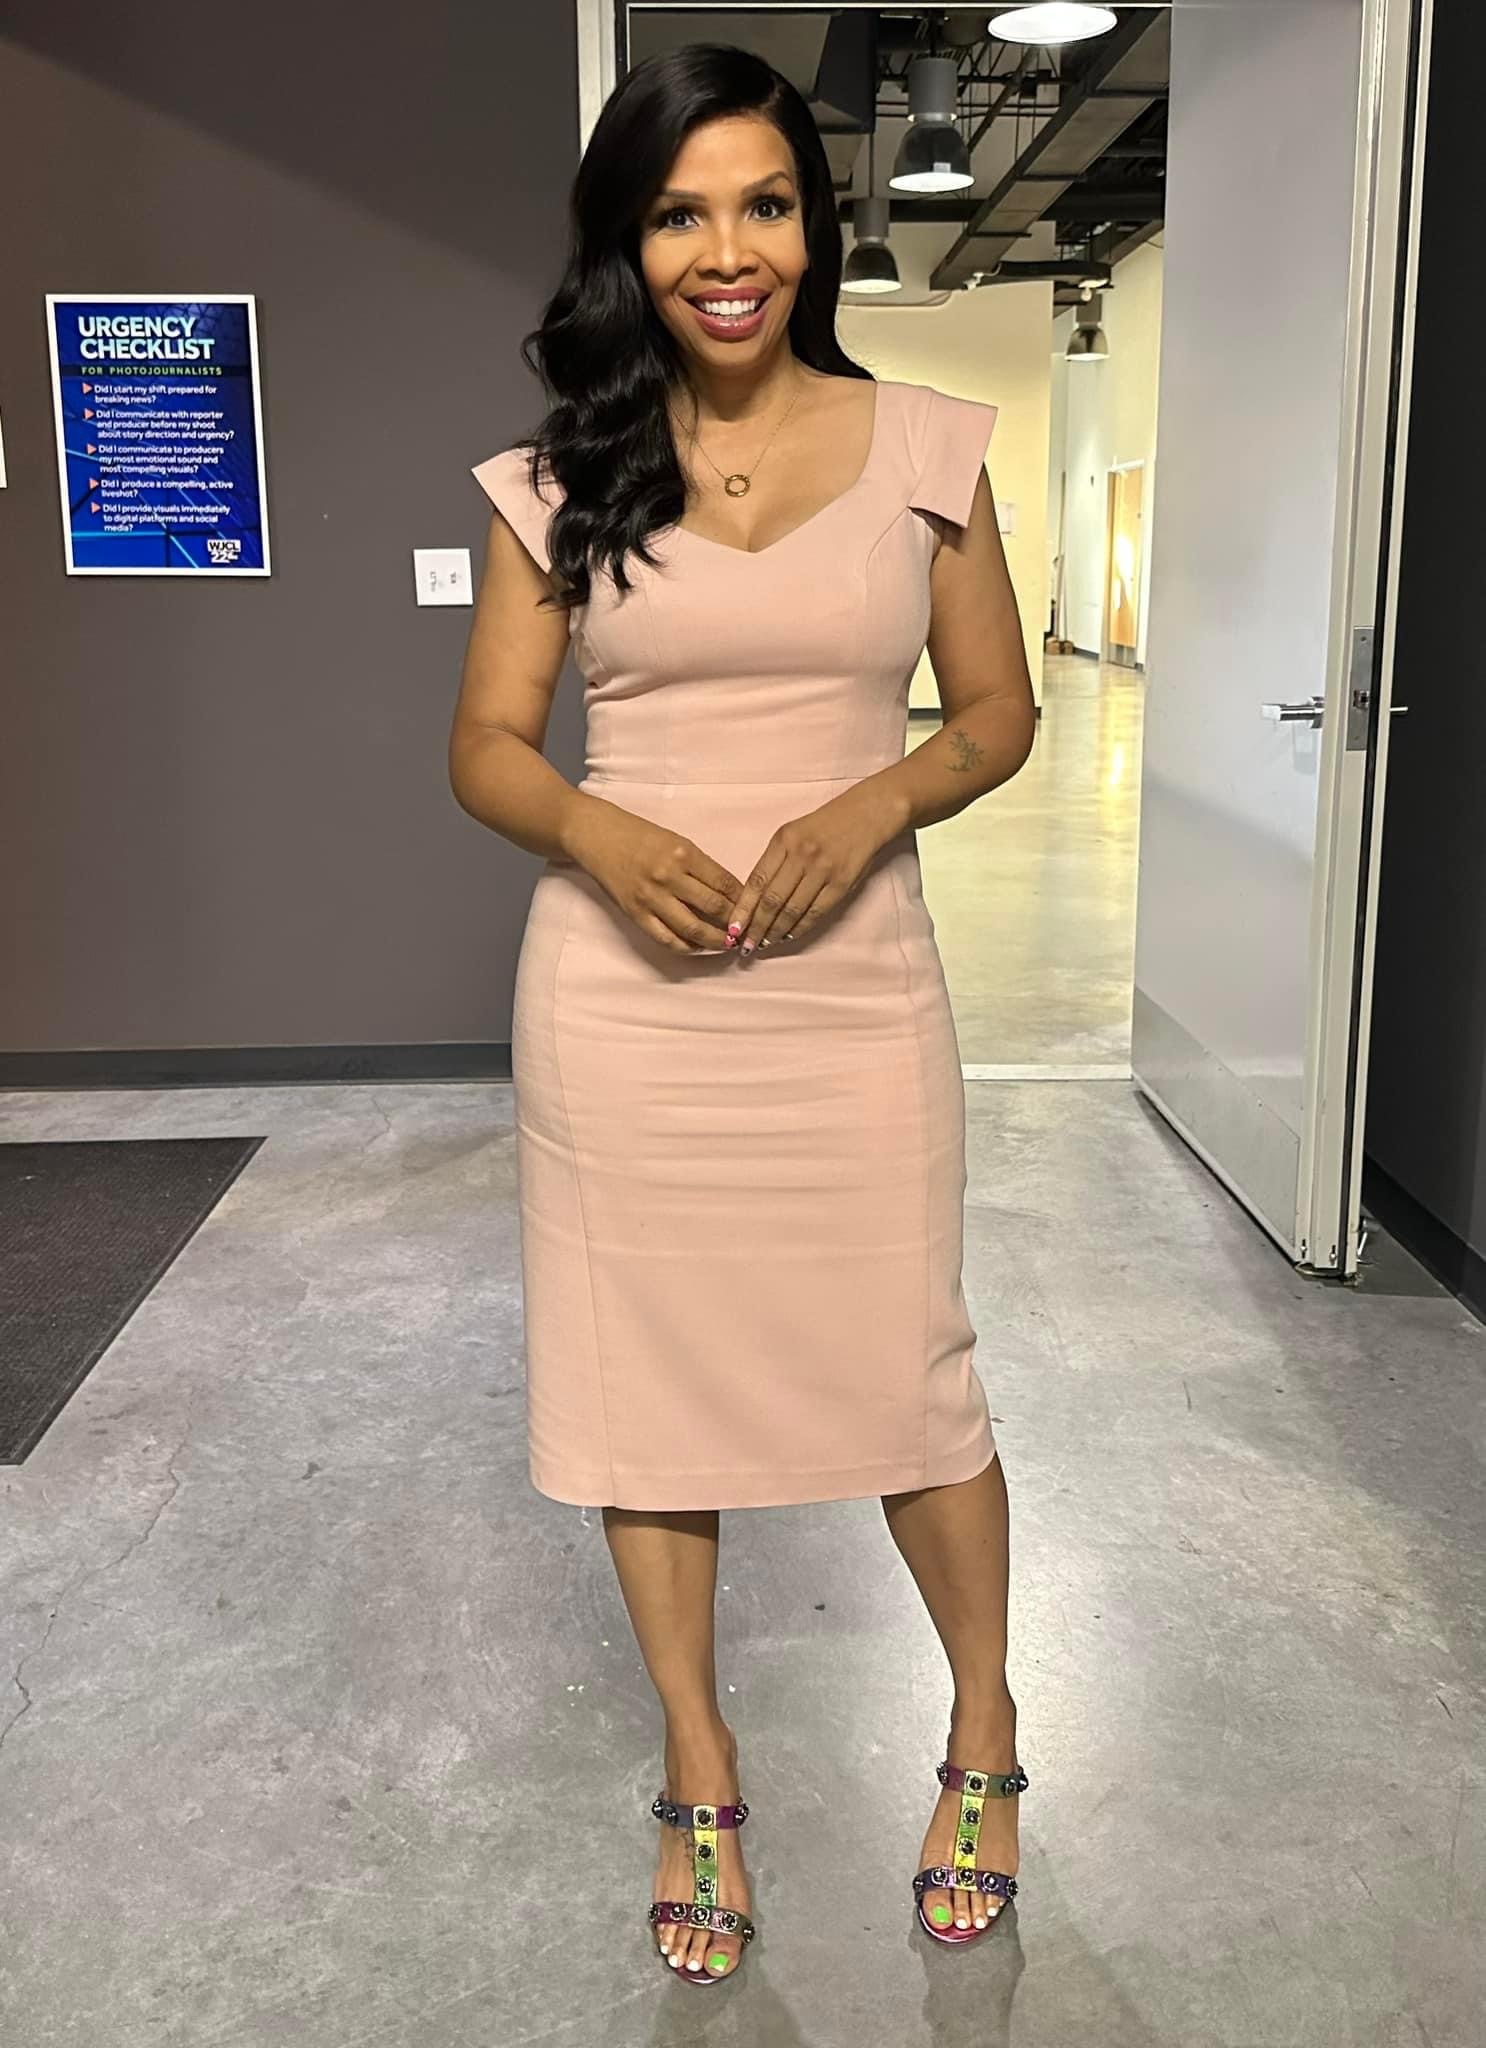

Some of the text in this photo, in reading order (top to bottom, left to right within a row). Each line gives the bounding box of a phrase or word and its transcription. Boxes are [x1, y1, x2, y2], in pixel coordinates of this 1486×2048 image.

[78, 316, 196, 337] URGENCY
[80, 338, 215, 360] CHECKLIST
[81, 367, 222, 375] FOR PHOTOJOURNALISTS
[94, 385, 109, 393] Did
[114, 386, 133, 394] start
[134, 387, 147, 395] my
[149, 385, 167, 393] shift
[168, 385, 204, 395] prepared
[205, 385, 217, 393] for
[95, 395, 156, 405] breaking news?
[96, 410, 111, 418] Did
[115, 410, 170, 418] communicate
[171, 410, 189, 418] with
[190, 411, 224, 420] reporter
[97, 420, 216, 430] and producer before my shoot
[98, 430, 234, 440] about story direction and urgency?
[98, 445, 113, 453] Did
[118, 445, 172, 453] communicate
[184, 445, 224, 455] producers
[99, 457, 112, 465] my
[136, 455, 176, 463] emotional
[177, 455, 202, 463] sound
[203, 455, 218, 463] and
[100, 465, 199, 475] most compelling visuals?
[101, 480, 115, 488] Did
[121, 480, 155, 490] produce
[162, 480, 208, 490] compelling,
[209, 480, 234, 488] active
[101, 490, 138, 498] liveshot?
[102, 504, 117, 513] Did
[122, 504, 153, 514] provide
[153, 504, 180, 513] visuals
[181, 504, 230, 515] immediately
[113, 515, 139, 525] digital
[139, 515, 178, 524] platforms
[195, 515, 219, 523] social
[104, 524, 134, 532] media?
[209, 541, 240, 550] WJCL
